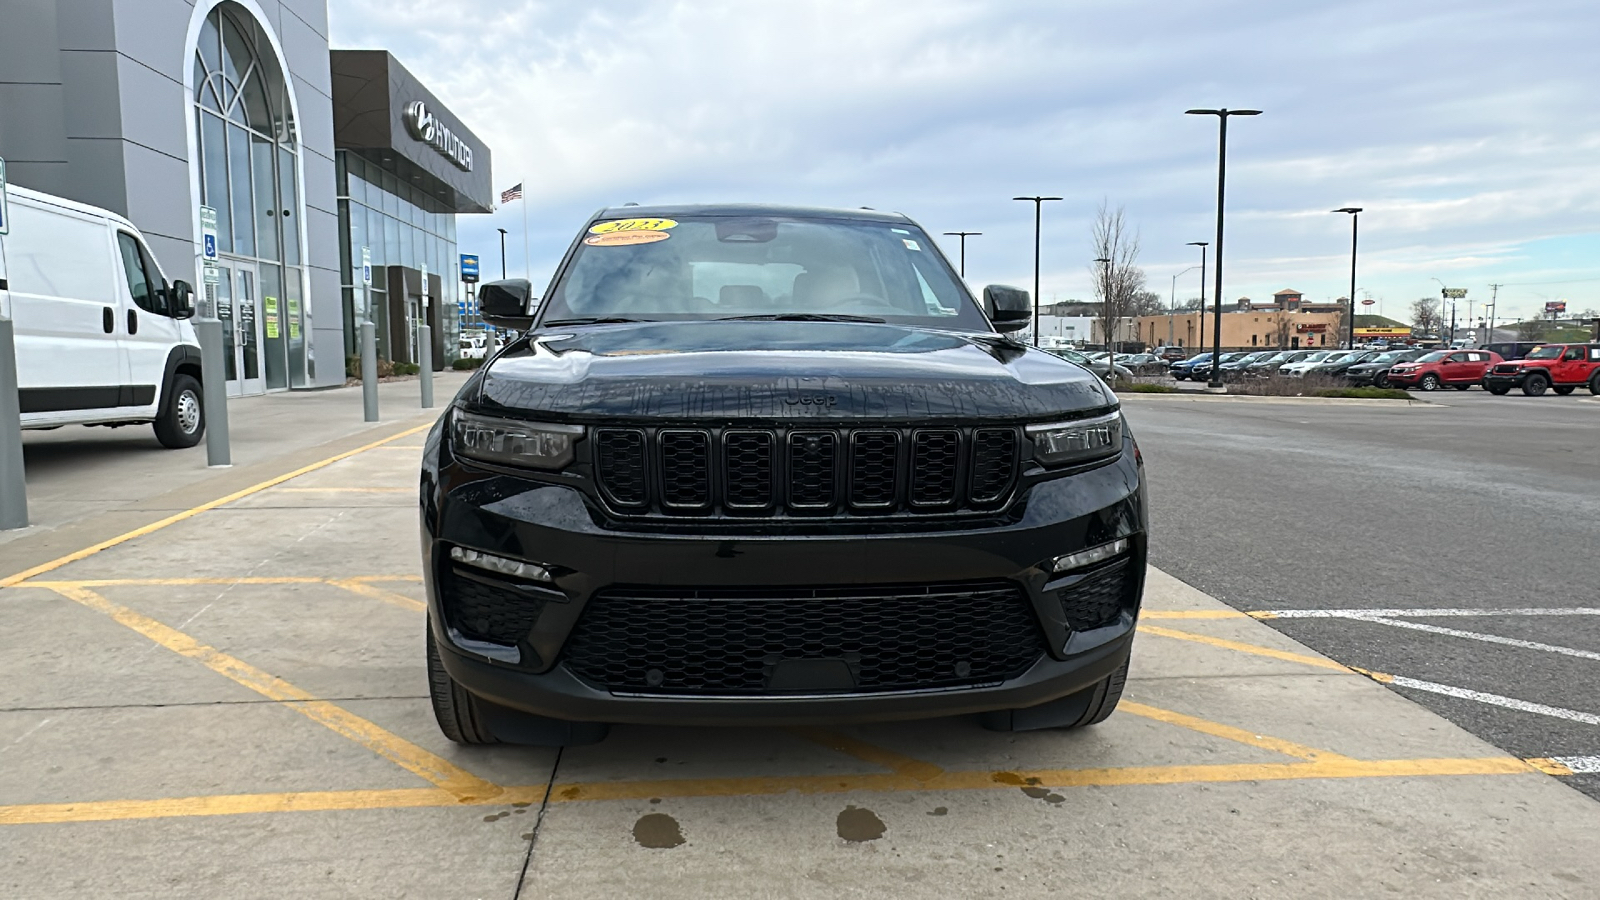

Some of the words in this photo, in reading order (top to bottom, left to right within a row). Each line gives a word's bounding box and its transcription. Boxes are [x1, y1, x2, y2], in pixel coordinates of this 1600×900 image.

[435, 118, 473, 172] HYUNDAI
[603, 220, 664, 232] 2023
[785, 390, 838, 408] Jeep
